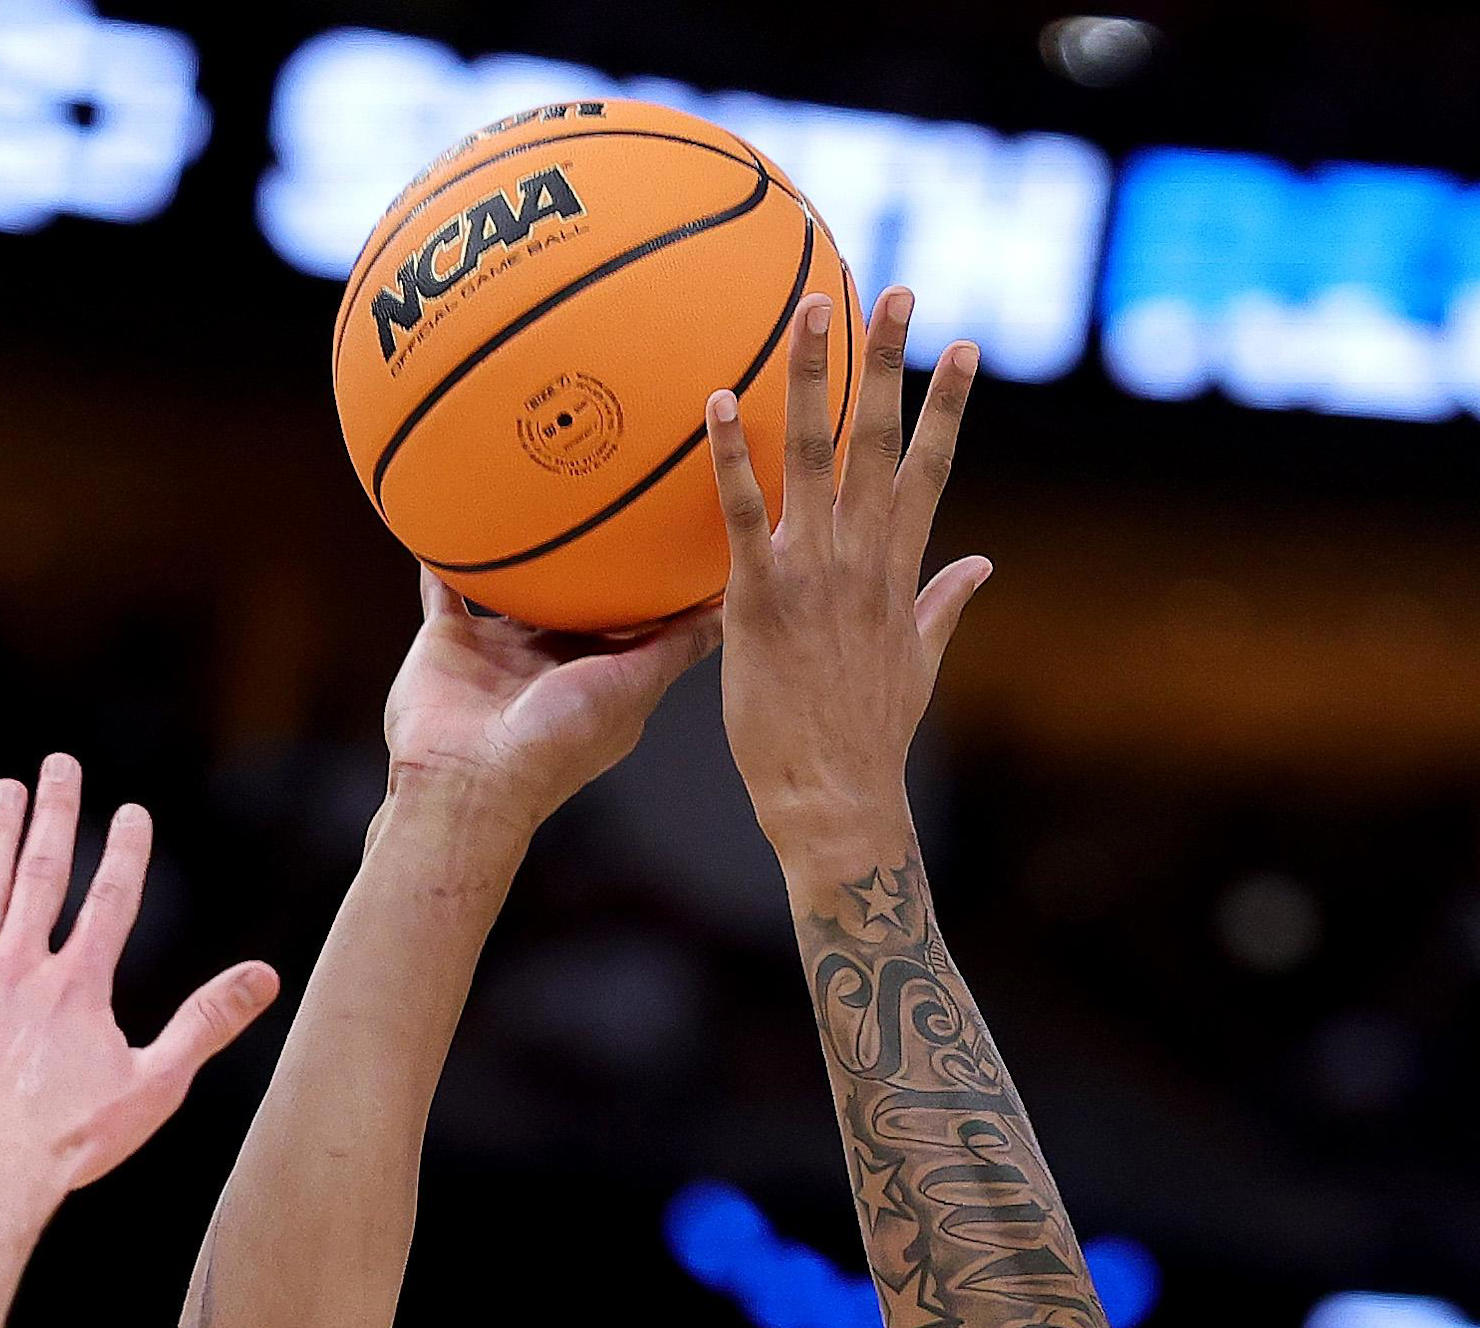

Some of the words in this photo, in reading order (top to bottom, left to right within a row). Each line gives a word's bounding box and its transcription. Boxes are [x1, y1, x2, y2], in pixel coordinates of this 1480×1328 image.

[370, 162, 588, 364] NCAA
[390, 301, 458, 379] OFFICIAL
[461, 252, 520, 298] GAME
[526, 224, 590, 257] BALL
